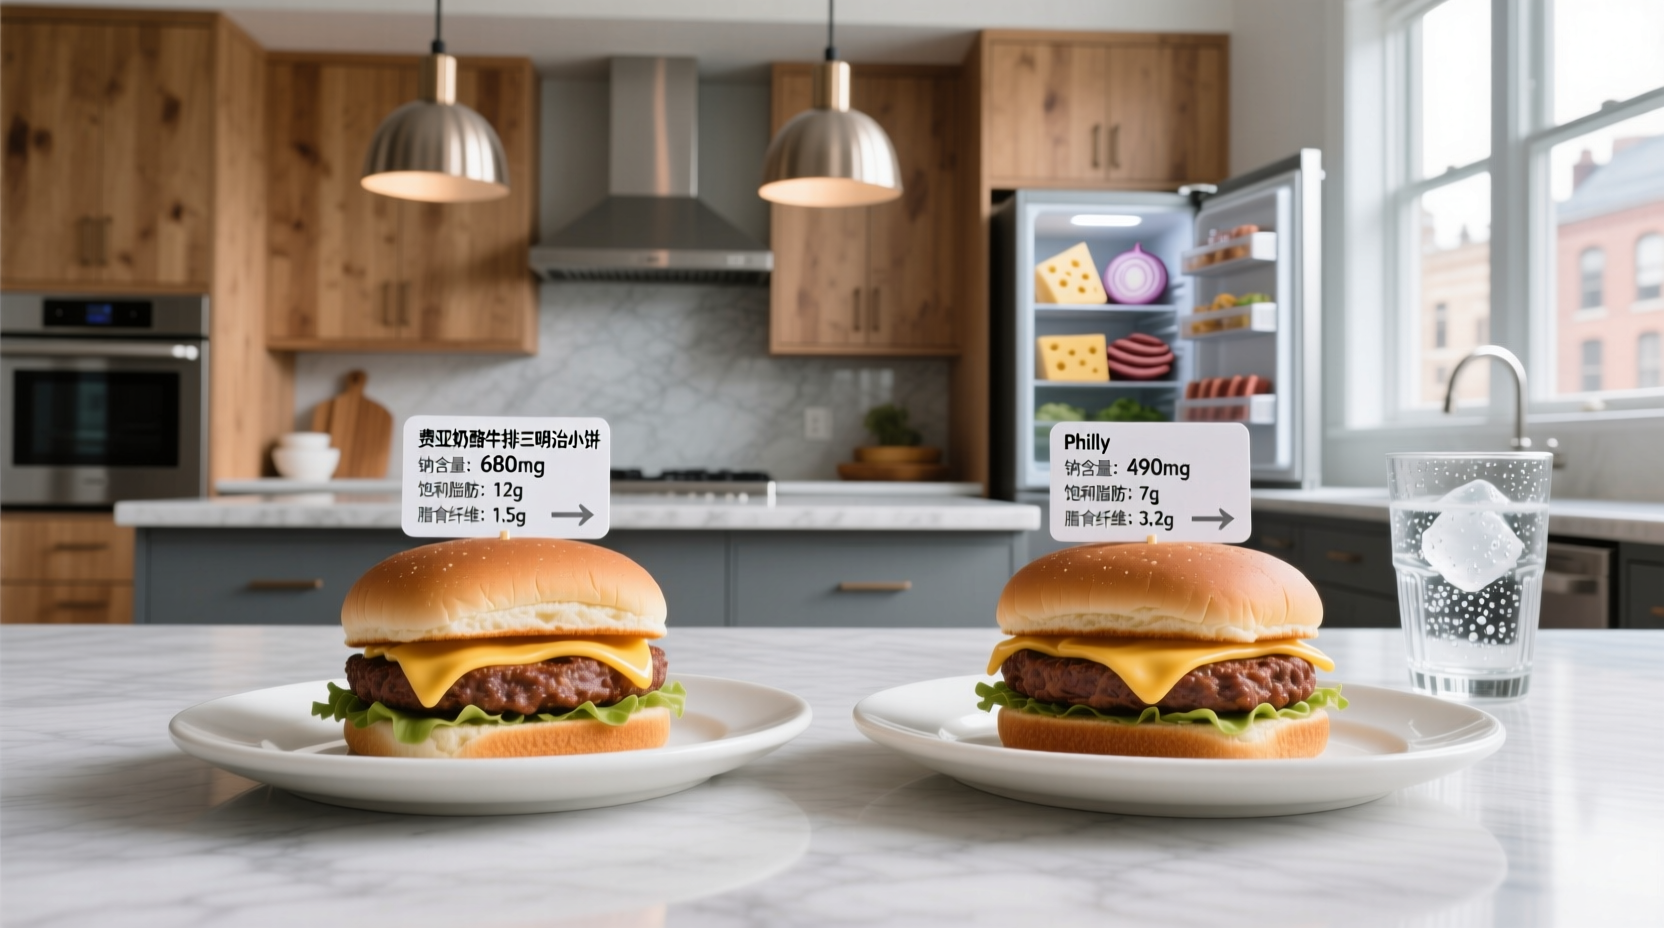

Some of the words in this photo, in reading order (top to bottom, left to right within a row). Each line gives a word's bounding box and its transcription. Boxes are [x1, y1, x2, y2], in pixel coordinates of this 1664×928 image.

[1064, 432, 1111, 455] Philly
[480, 454, 545, 479] 680mg
[1126, 457, 1191, 482] 490mg
[493, 481, 523, 503] 12g
[1138, 485, 1160, 506] 7g
[493, 506, 526, 528] 1.5g
[1138, 510, 1174, 532] 3.2g
